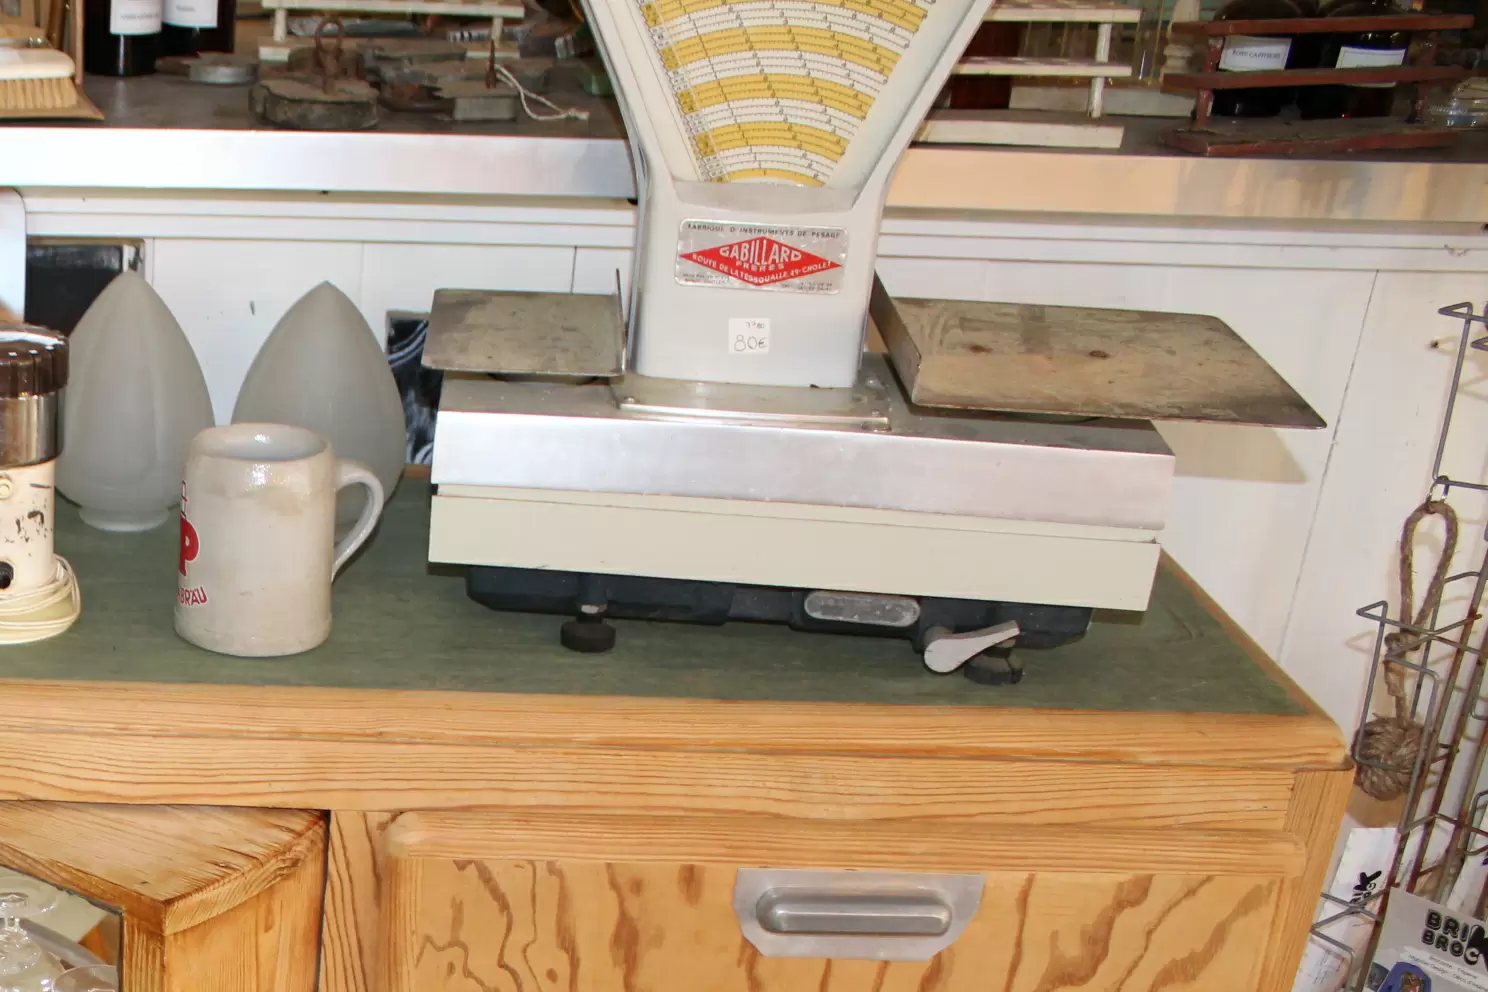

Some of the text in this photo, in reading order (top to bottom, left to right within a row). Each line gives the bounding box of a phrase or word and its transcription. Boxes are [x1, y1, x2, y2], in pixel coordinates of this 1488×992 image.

[692, 252, 717, 268] ROUTE
[719, 263, 729, 273] DE
[718, 239, 803, 265] GABILLARD
[734, 334, 769, 352] 80€
[1421, 928, 1480, 966] BROC
